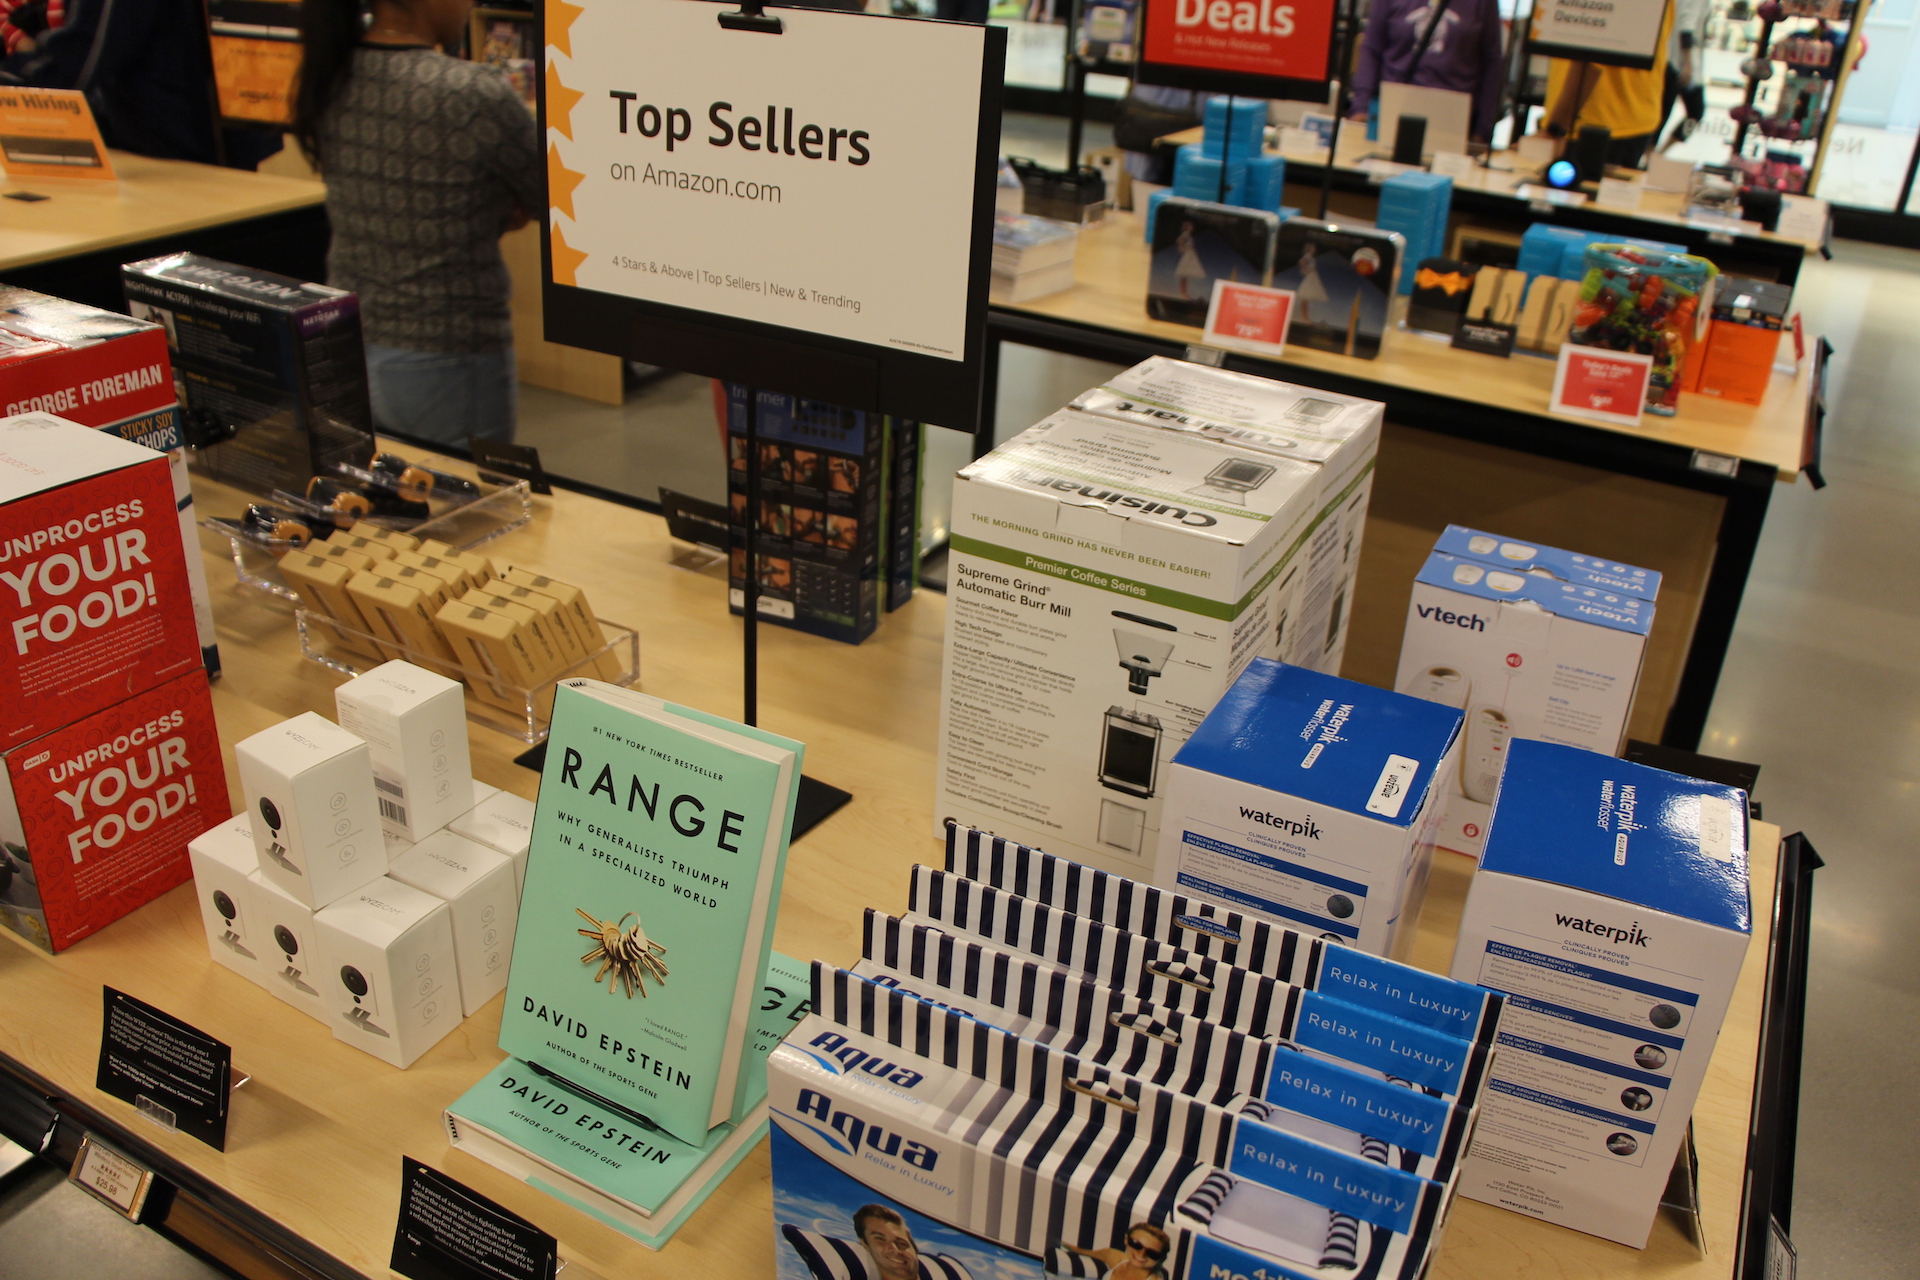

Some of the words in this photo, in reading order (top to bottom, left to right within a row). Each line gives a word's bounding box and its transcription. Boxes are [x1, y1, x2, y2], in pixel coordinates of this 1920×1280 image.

[1174, 0, 1295, 38] Deals
[1554, 10, 1607, 27] Devices
[21, 94, 80, 114] Hiring
[609, 90, 692, 151] Top
[708, 101, 870, 166] Sellers
[610, 160, 635, 182] on
[642, 163, 781, 204] Amazon.com
[124, 278, 164, 300] NIGHTHAWK
[612, 256, 620, 267] 4
[621, 256, 647, 272] Stars
[649, 261, 658, 273] &
[661, 263, 695, 281] Above
[703, 270, 723, 287] Top
[725, 275, 761, 293] Sellers
[770, 283, 796, 299] New
[798, 288, 808, 301] &
[811, 290, 861, 314] Trending
[303, 309, 340, 327] NETGEAR
[6, 386, 79, 417] GEORGE
[82, 364, 164, 405] FOREMAN
[120, 418, 154, 440] STICKY
[155, 411, 174, 427] SOY
[138, 426, 178, 450] CHOPS
[0, 499, 144, 562] UNPROCESS
[971, 513, 990, 525] THE
[992, 517, 1039, 537] MORNING
[1042, 530, 1074, 546] GRIND
[1077, 539, 1098, 552] HAS
[1100, 545, 1135, 561] NEVER
[1138, 555, 1166, 569] BEEN
[1170, 563, 1212, 580] EASIER!
[0, 529, 151, 608] YOUR
[957, 563, 1010, 586] Supreme
[1025, 556, 1069, 577] Premier
[1070, 567, 1108, 587] Coffee
[1110, 578, 1147, 597] Series
[12, 572, 158, 656] FOOD!
[956, 578, 1016, 603] Automatic
[1020, 595, 1046, 611] Burr
[1050, 603, 1072, 618] Mill
[1416, 603, 1486, 632] vtech
[1575, 602, 1638, 626] vtech
[1299, 698, 1335, 742] waterflosser
[1317, 702, 1354, 744] waterpik
[49, 709, 184, 783] UNPROCESS
[593, 725, 603, 736] #1
[606, 730, 623, 743] NEW
[625, 737, 646, 752] YORK
[649, 748, 672, 763] TIMES
[674, 757, 724, 782] BESTSELLER
[54, 737, 191, 822] YOUR
[561, 747, 745, 854] RANGE
[1380, 773, 1400, 799] amazon
[67, 774, 198, 865] FOOD!
[1239, 805, 1323, 841] waterpik
[1597, 778, 1615, 832] waterflosser
[1617, 784, 1648, 833] waterpik
[557, 809, 582, 828] WHY
[587, 823, 665, 865] GENERALISTS
[671, 860, 730, 891] TRIUMPH
[1246, 836, 1278, 850] CLINIQUES
[1248, 831, 1282, 846] CLINICALLY
[1282, 841, 1307, 853] PROVEN
[559, 833, 572, 846] IN
[577, 842, 586, 852] A
[592, 848, 666, 888] SPECIALIZED
[673, 883, 718, 909] WORLD
[1555, 912, 1651, 948] waterpik
[1563, 939, 1602, 953] CLINICALLY
[1603, 948, 1631, 961] PROVEN
[1491, 942, 1522, 957] EFFECTIVE
[1523, 949, 1547, 963] PLAQUE
[1513, 953, 1557, 971] EFFICACEMENT
[1557, 964, 1566, 973] LA
[1561, 945, 1597, 959] CLINIQUES
[1598, 952, 1630, 967] PROUVÉS
[771, 967, 811, 985] BESTSELLE
[1330, 966, 1379, 993] Relax
[1385, 983, 1401, 1000] in
[1408, 990, 1472, 1022] Luxury
[523, 996, 588, 1039] DAVID
[600, 1033, 692, 1091] EPSTEIN
[650, 1019, 664, 1031] loved
[665, 1037, 688, 1051] Gladwell
[1308, 1011, 1358, 1040] Relax
[1365, 1030, 1382, 1047] in
[1390, 1038, 1455, 1073] Luxury
[546, 1041, 577, 1060] AUTHOR
[580, 1056, 591, 1066] OF
[592, 1062, 607, 1074] THE
[608, 1070, 636, 1088] SPORTS
[638, 1085, 658, 1100] GENE
[808, 1031, 927, 1089] Aqua
[851, 1072, 877, 1089] Relax
[878, 1082, 888, 1093] in
[888, 1086, 923, 1106] Luxury
[1280, 1070, 1332, 1099] Relax
[1340, 1088, 1357, 1107] in
[1365, 1097, 1434, 1135] Luxury
[500, 1077, 569, 1116] DAVID
[575, 1114, 671, 1165] EPSTEIN
[509, 1110, 540, 1129] AUTHOR
[542, 1126, 555, 1136] OF
[555, 1132, 571, 1143] THE
[570, 1139, 600, 1158] SPORTS
[600, 1156, 623, 1170] GENE
[796, 1087, 941, 1172] Aqua
[864, 1151, 897, 1171] Relax
[899, 1166, 911, 1177] in
[913, 1171, 955, 1196] Luxury
[1243, 1144, 1297, 1174] Relax
[1306, 1165, 1324, 1183] in
[1333, 1172, 1406, 1212] Luxury
[1499, 1198, 1544, 1215] waterpik.com
